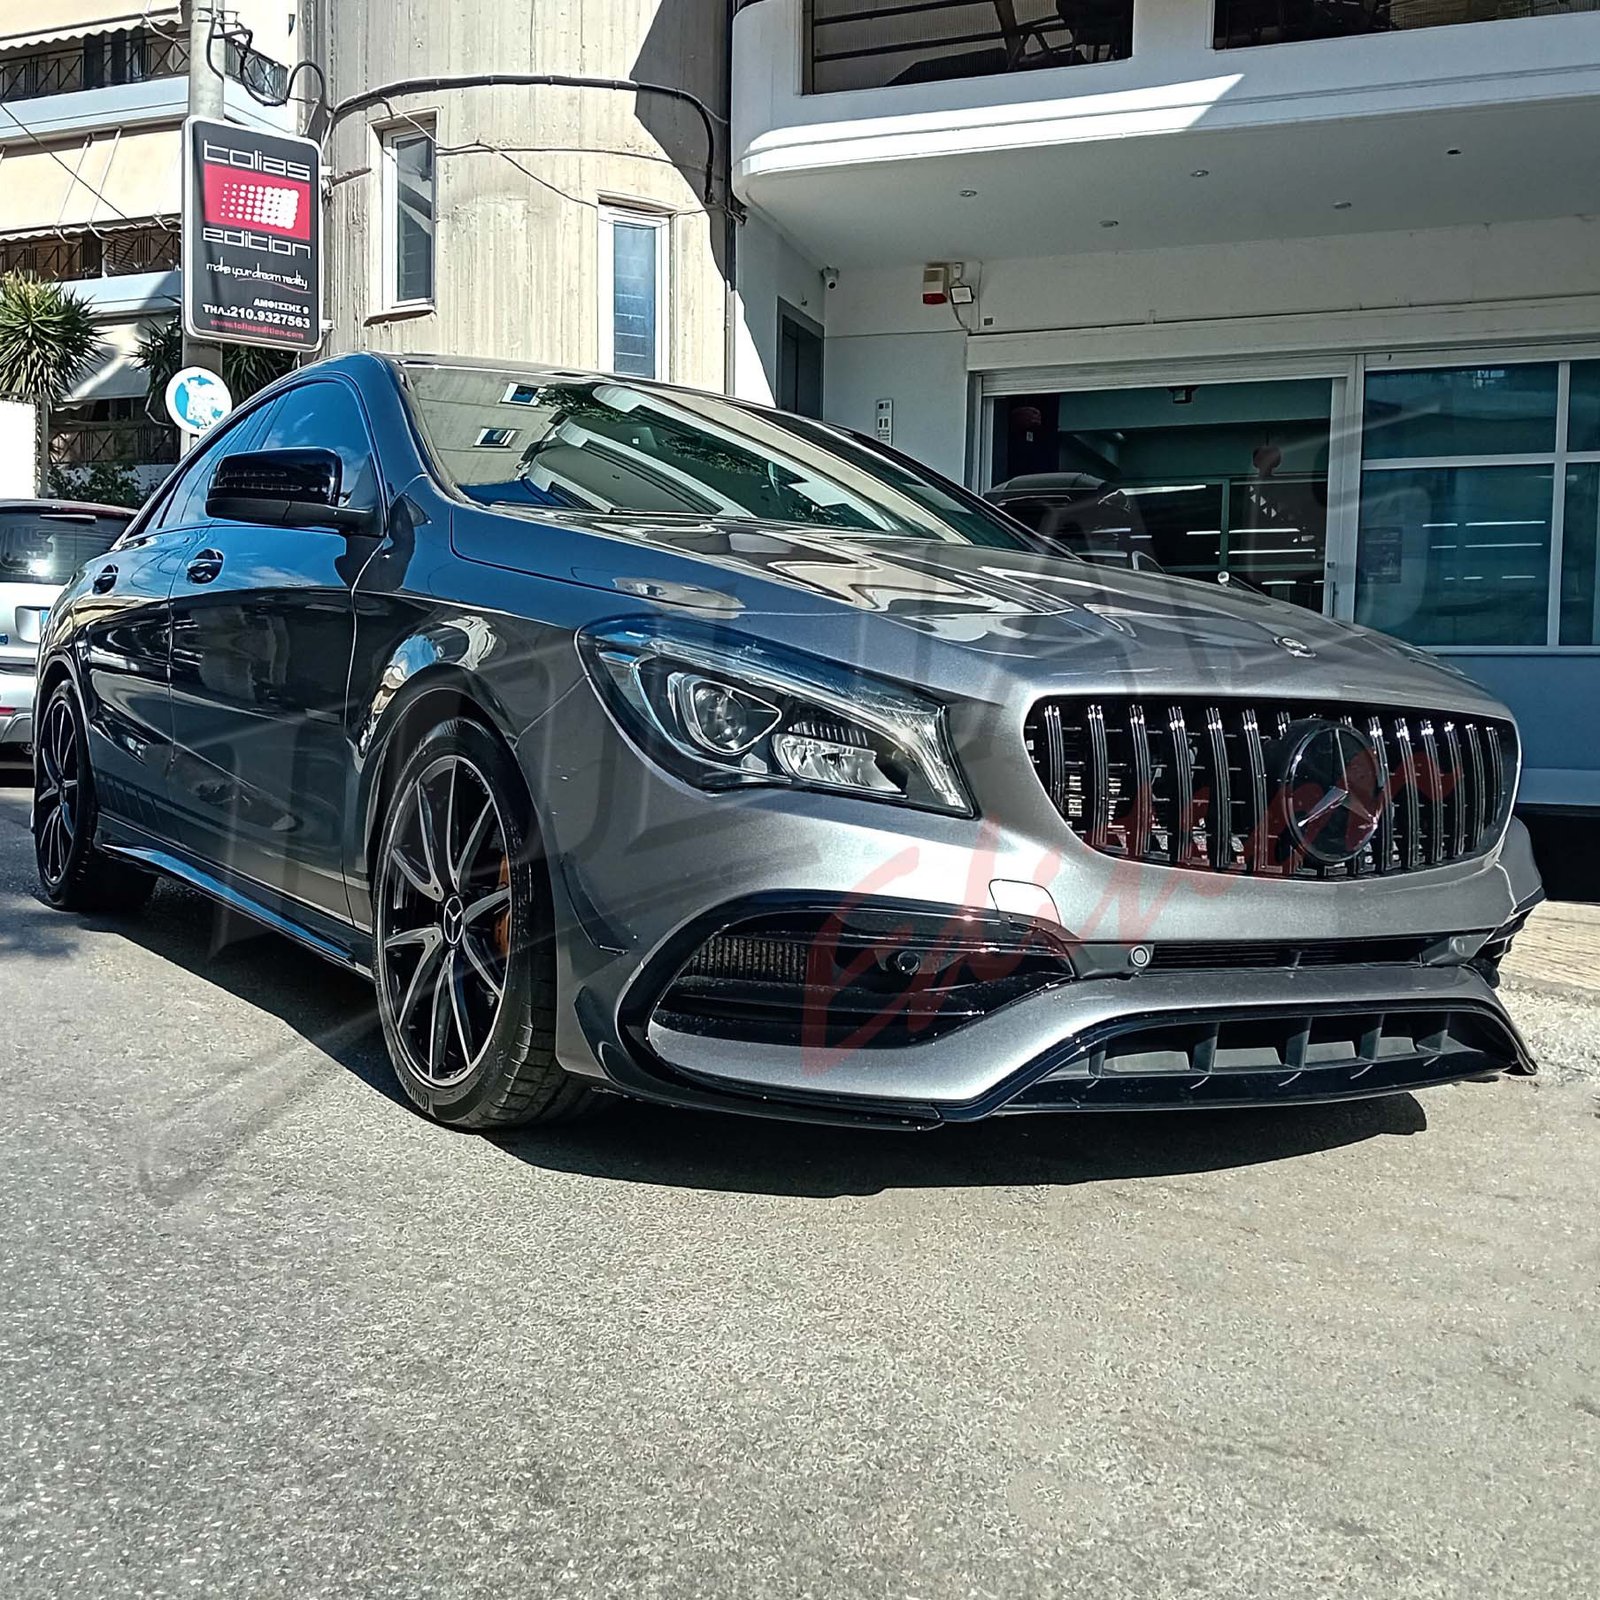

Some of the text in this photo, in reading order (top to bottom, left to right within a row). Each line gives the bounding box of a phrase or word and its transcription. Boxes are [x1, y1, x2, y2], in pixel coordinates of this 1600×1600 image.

[203, 139, 310, 181] tolias
[203, 227, 310, 259] edition
[232, 266, 252, 278] your
[252, 262, 281, 282] dream
